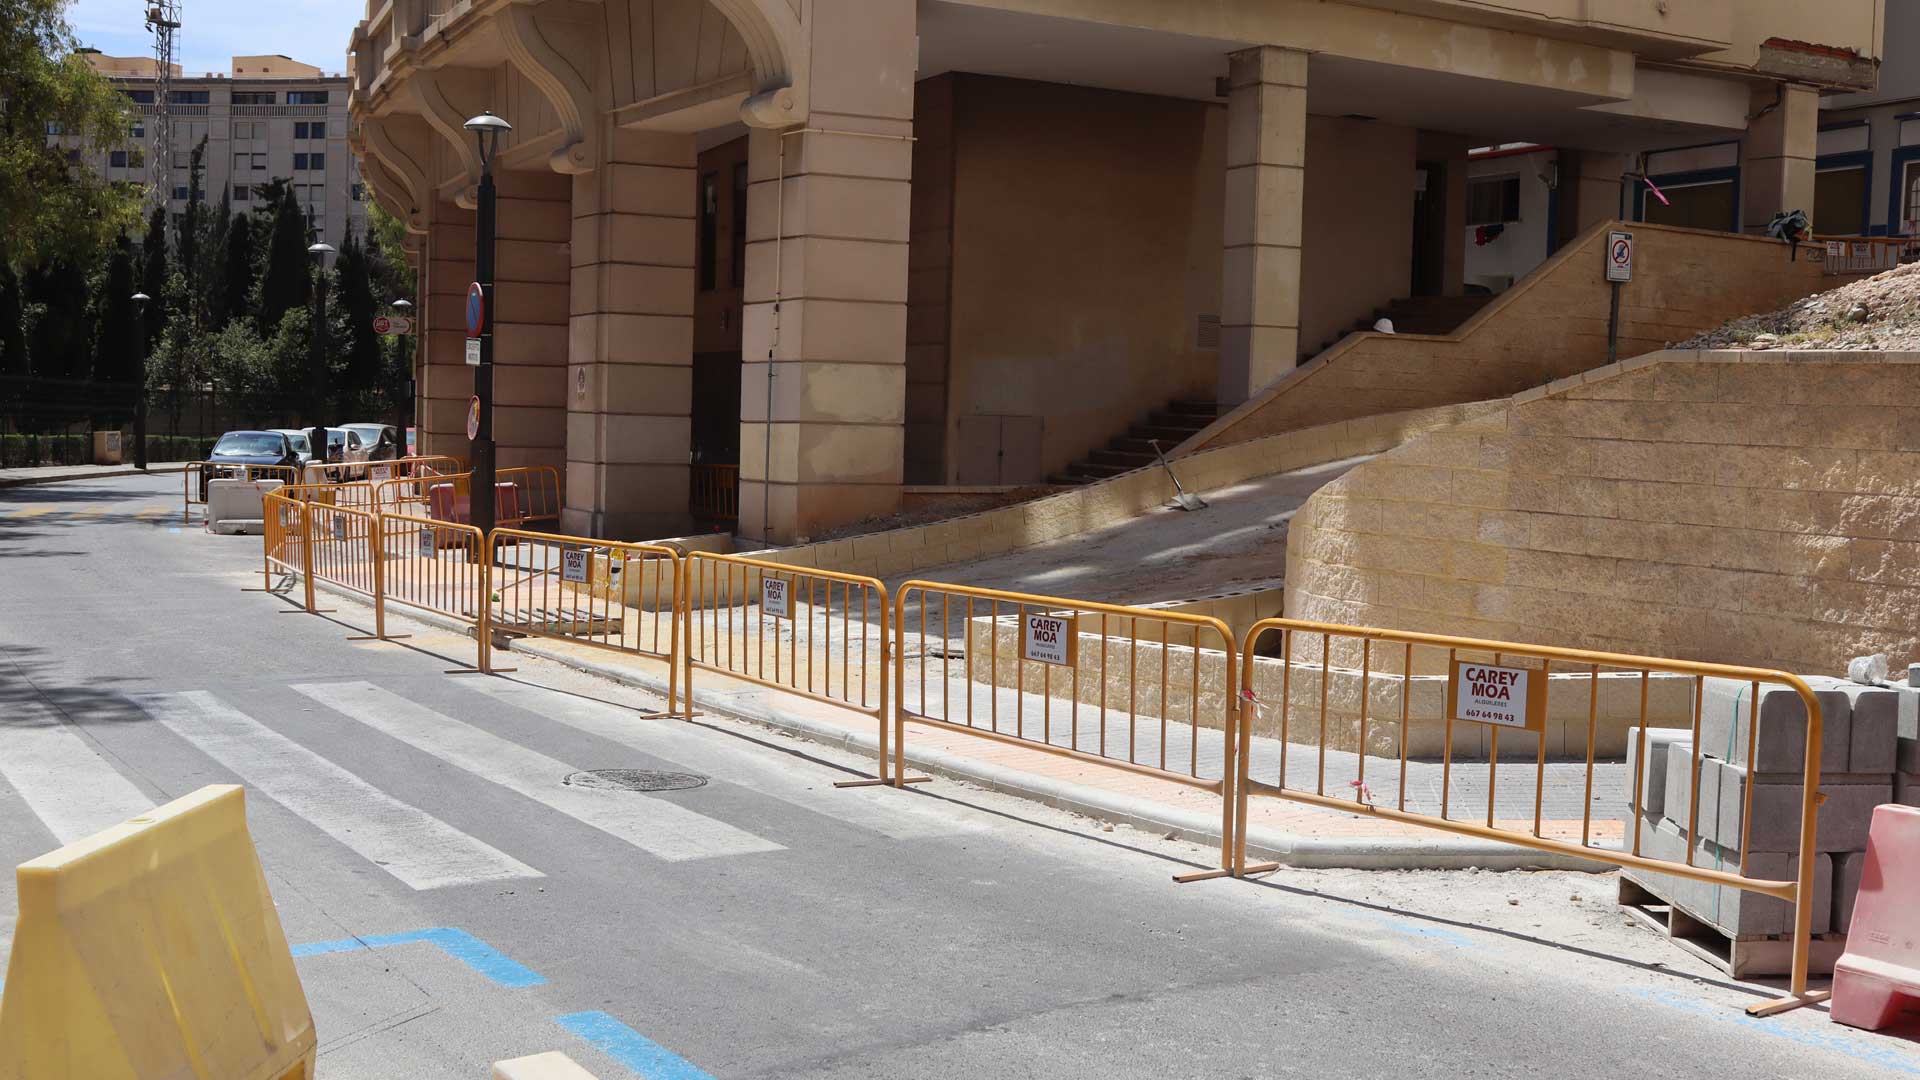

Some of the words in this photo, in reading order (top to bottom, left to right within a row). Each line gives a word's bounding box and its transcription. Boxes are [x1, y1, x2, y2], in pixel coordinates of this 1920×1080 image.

[565, 551, 585, 561] CAREY
[765, 580, 785, 591] CAREY
[767, 590, 782, 600] MOA
[1030, 618, 1062, 632] CAREY
[1034, 630, 1057, 643] MOA
[1465, 667, 1519, 686] CAREY
[1471, 682, 1510, 700] MOA
[1466, 709, 1480, 717] 667
[1481, 710, 1491, 719] 64
[1493, 712, 1503, 721] 98
[1504, 714, 1515, 722] 43
